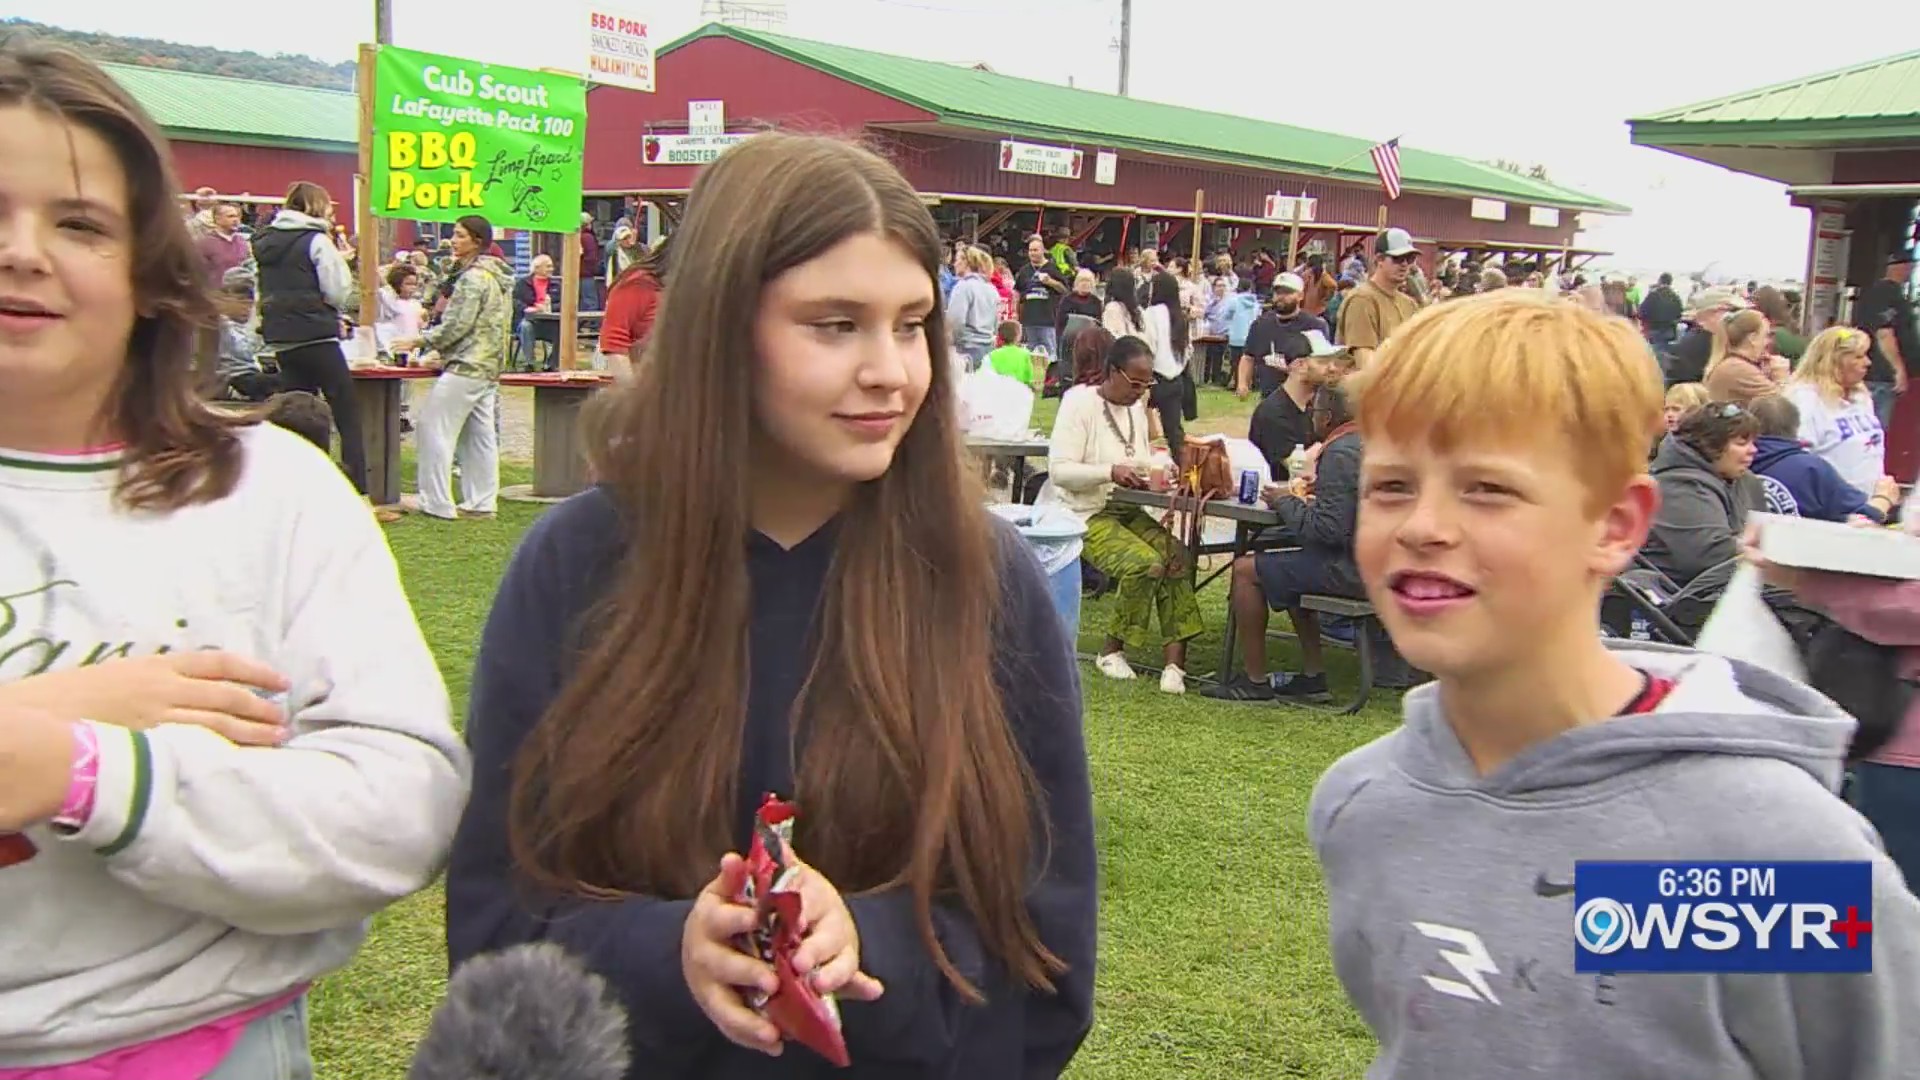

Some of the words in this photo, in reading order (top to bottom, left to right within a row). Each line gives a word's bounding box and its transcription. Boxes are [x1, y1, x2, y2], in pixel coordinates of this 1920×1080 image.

[591, 12, 615, 31] BBQ
[618, 18, 648, 38] PORK
[423, 65, 475, 97] Cub
[478, 74, 549, 108] Scout
[391, 94, 495, 127] LaFayette
[495, 110, 542, 134] Pack
[543, 115, 575, 138] 100
[387, 131, 478, 170] BBQ
[523, 144, 573, 178] Lizard
[668, 149, 718, 162] BOOSTER
[1015, 158, 1047, 173] BOOSTER
[1051, 162, 1069, 176] CLUB
[385, 170, 485, 211] Pork
